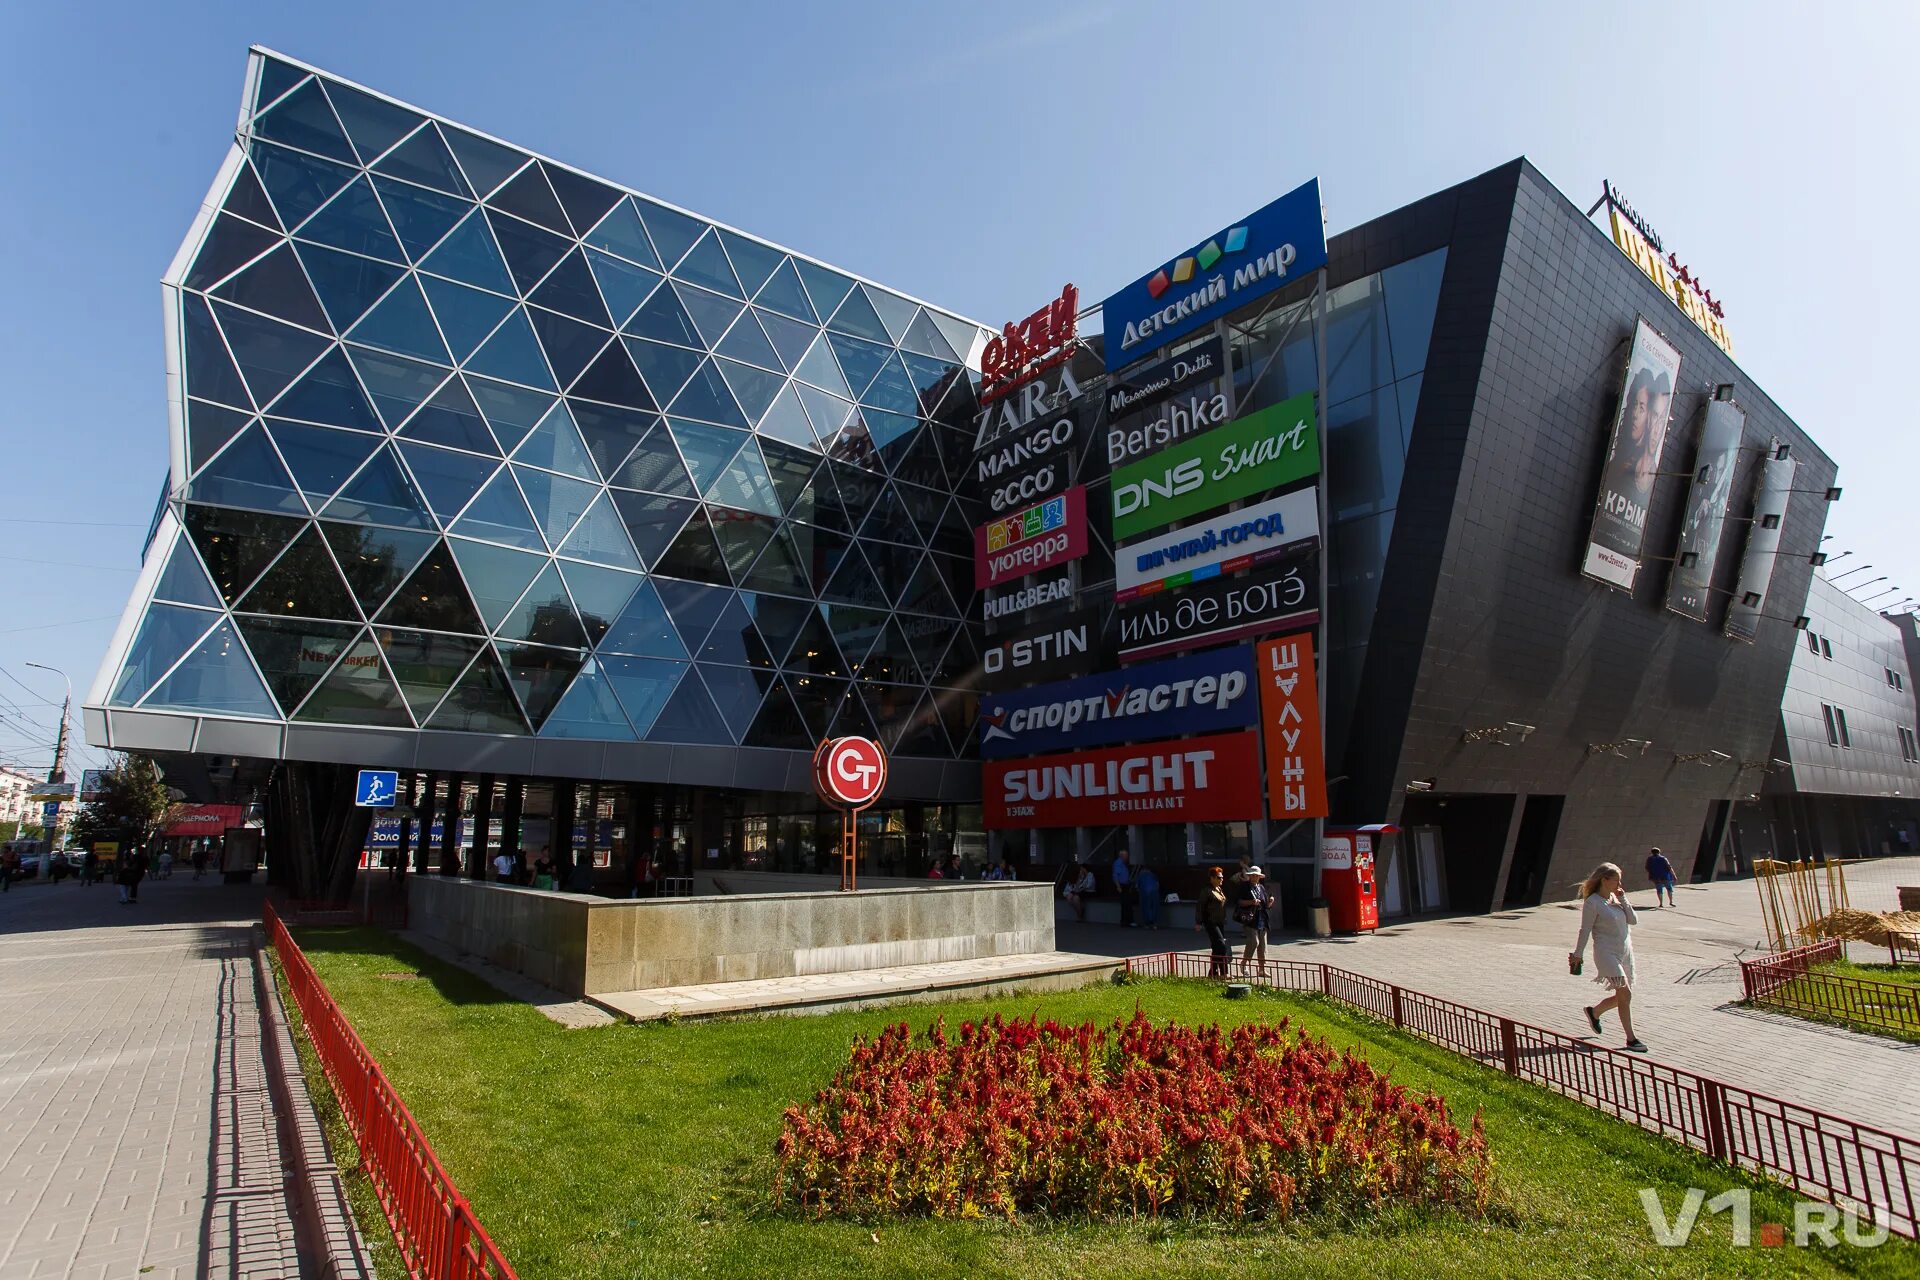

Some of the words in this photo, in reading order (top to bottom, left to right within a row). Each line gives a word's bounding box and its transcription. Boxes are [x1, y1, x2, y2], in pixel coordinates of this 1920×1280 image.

[1121, 273, 1227, 350] Детский
[1232, 242, 1297, 291] мир
[973, 366, 1085, 451] ZARA
[1110, 377, 1170, 413] Massimo
[1172, 353, 1214, 383] Dutti
[979, 418, 1075, 482] MANGO
[1108, 392, 1229, 464] Bershka
[1113, 457, 1205, 518] DNS
[1211, 419, 1308, 481] Smart
[1604, 490, 1647, 529] КРЫМ
[988, 531, 1069, 580] уютерра
[1164, 512, 1284, 566] ЧИТАЙ-ГОРОД
[984, 577, 1073, 620] PULL&BEAR
[984, 625, 1088, 674] O'STIN
[1120, 610, 1169, 644] ИЛЬ
[1271, 642, 1307, 811] ШАЛУНЫ
[1004, 750, 1215, 803] SUNLIGHT
[1109, 796, 1186, 812] BRILLIANT
